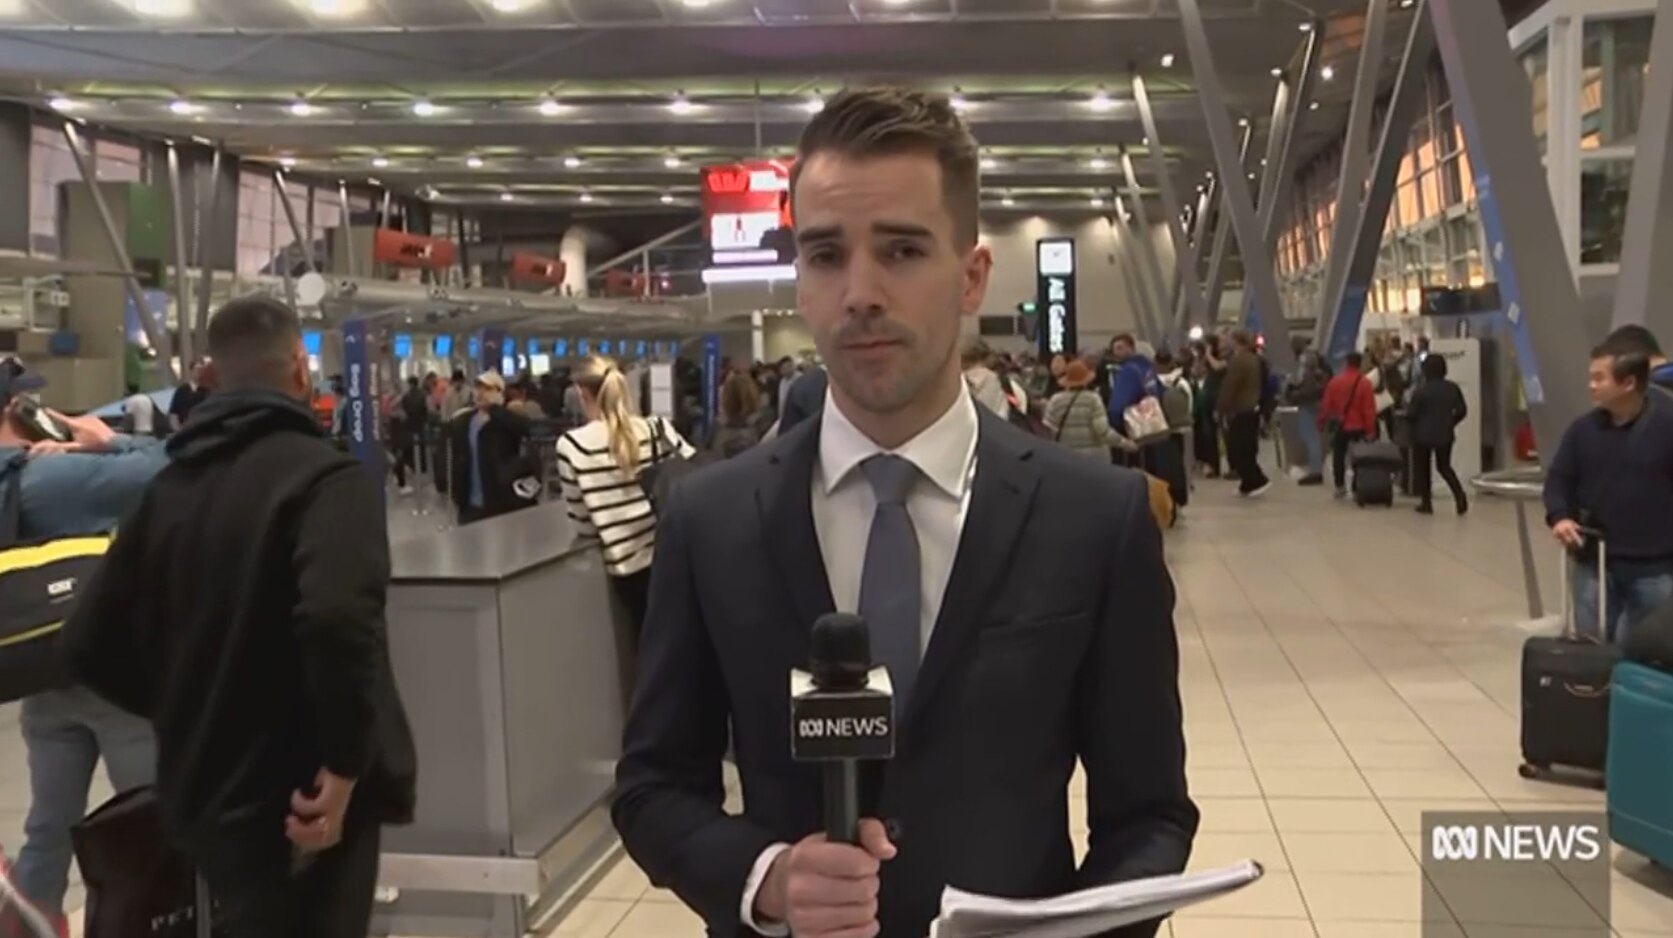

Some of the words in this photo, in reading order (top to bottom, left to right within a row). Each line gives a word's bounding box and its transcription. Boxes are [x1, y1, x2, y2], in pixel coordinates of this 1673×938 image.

[1048, 277, 1065, 301] All
[1049, 303, 1065, 353] Gates
[349, 363, 361, 398] Bag
[352, 400, 363, 443] Drop
[826, 717, 888, 736] NEWS
